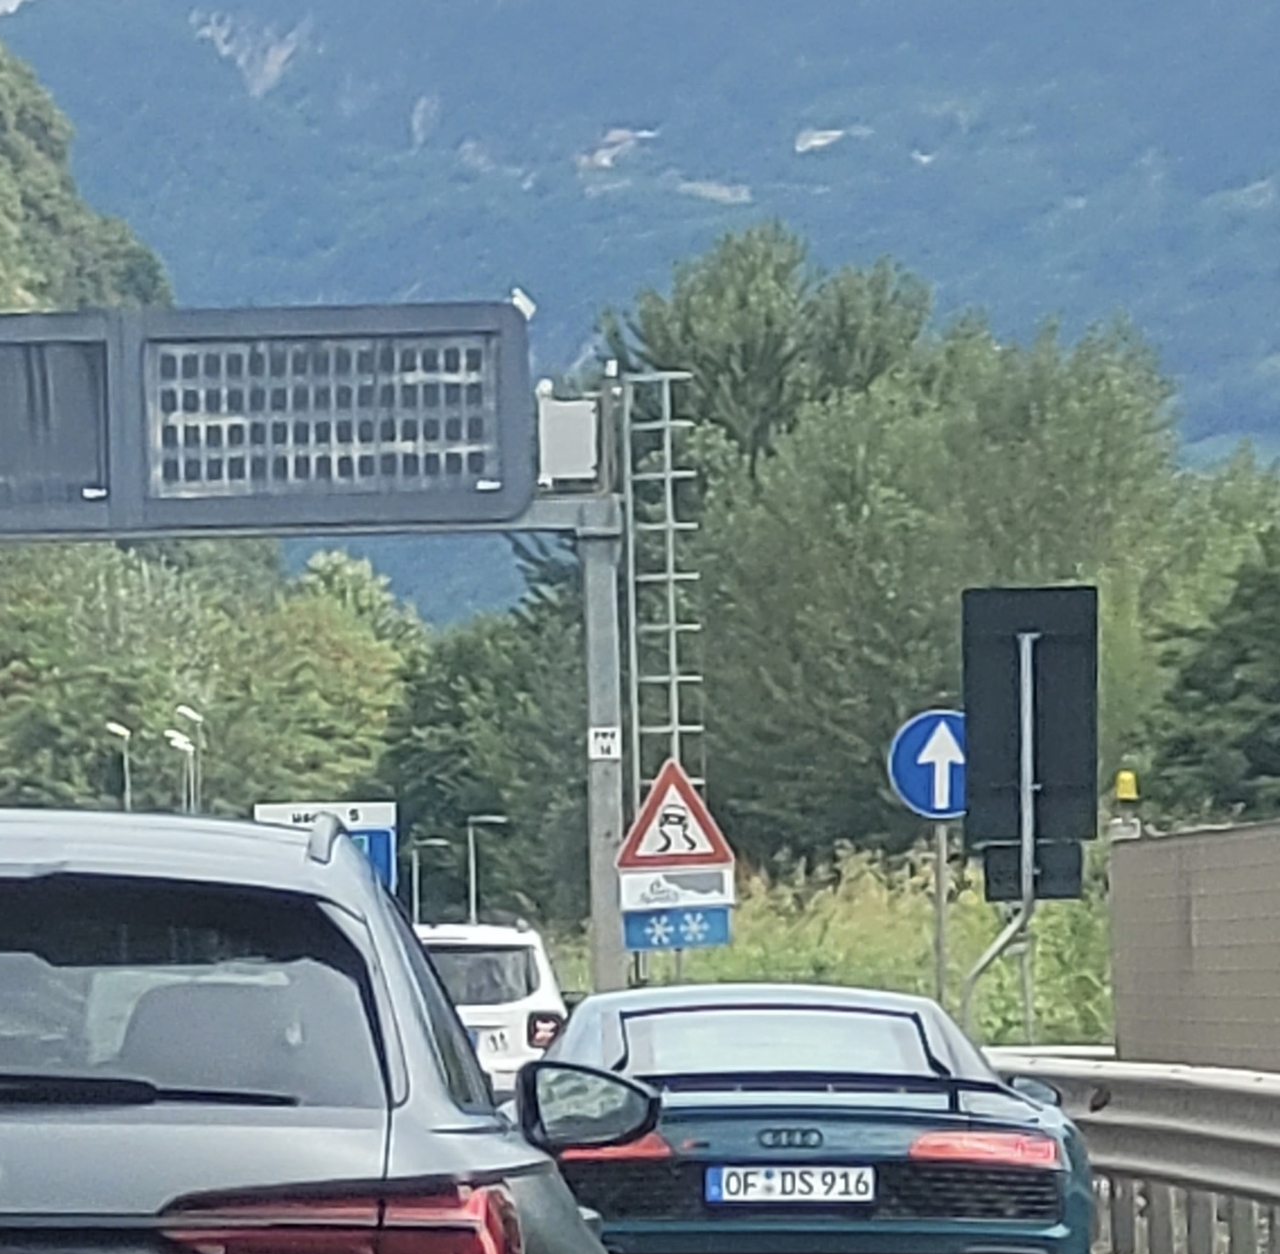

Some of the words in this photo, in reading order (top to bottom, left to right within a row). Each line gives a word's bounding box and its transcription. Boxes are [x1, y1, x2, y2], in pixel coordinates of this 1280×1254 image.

[724, 1170, 759, 1197] OF
[779, 1170, 815, 1197] DS
[821, 1170, 870, 1197] 916
